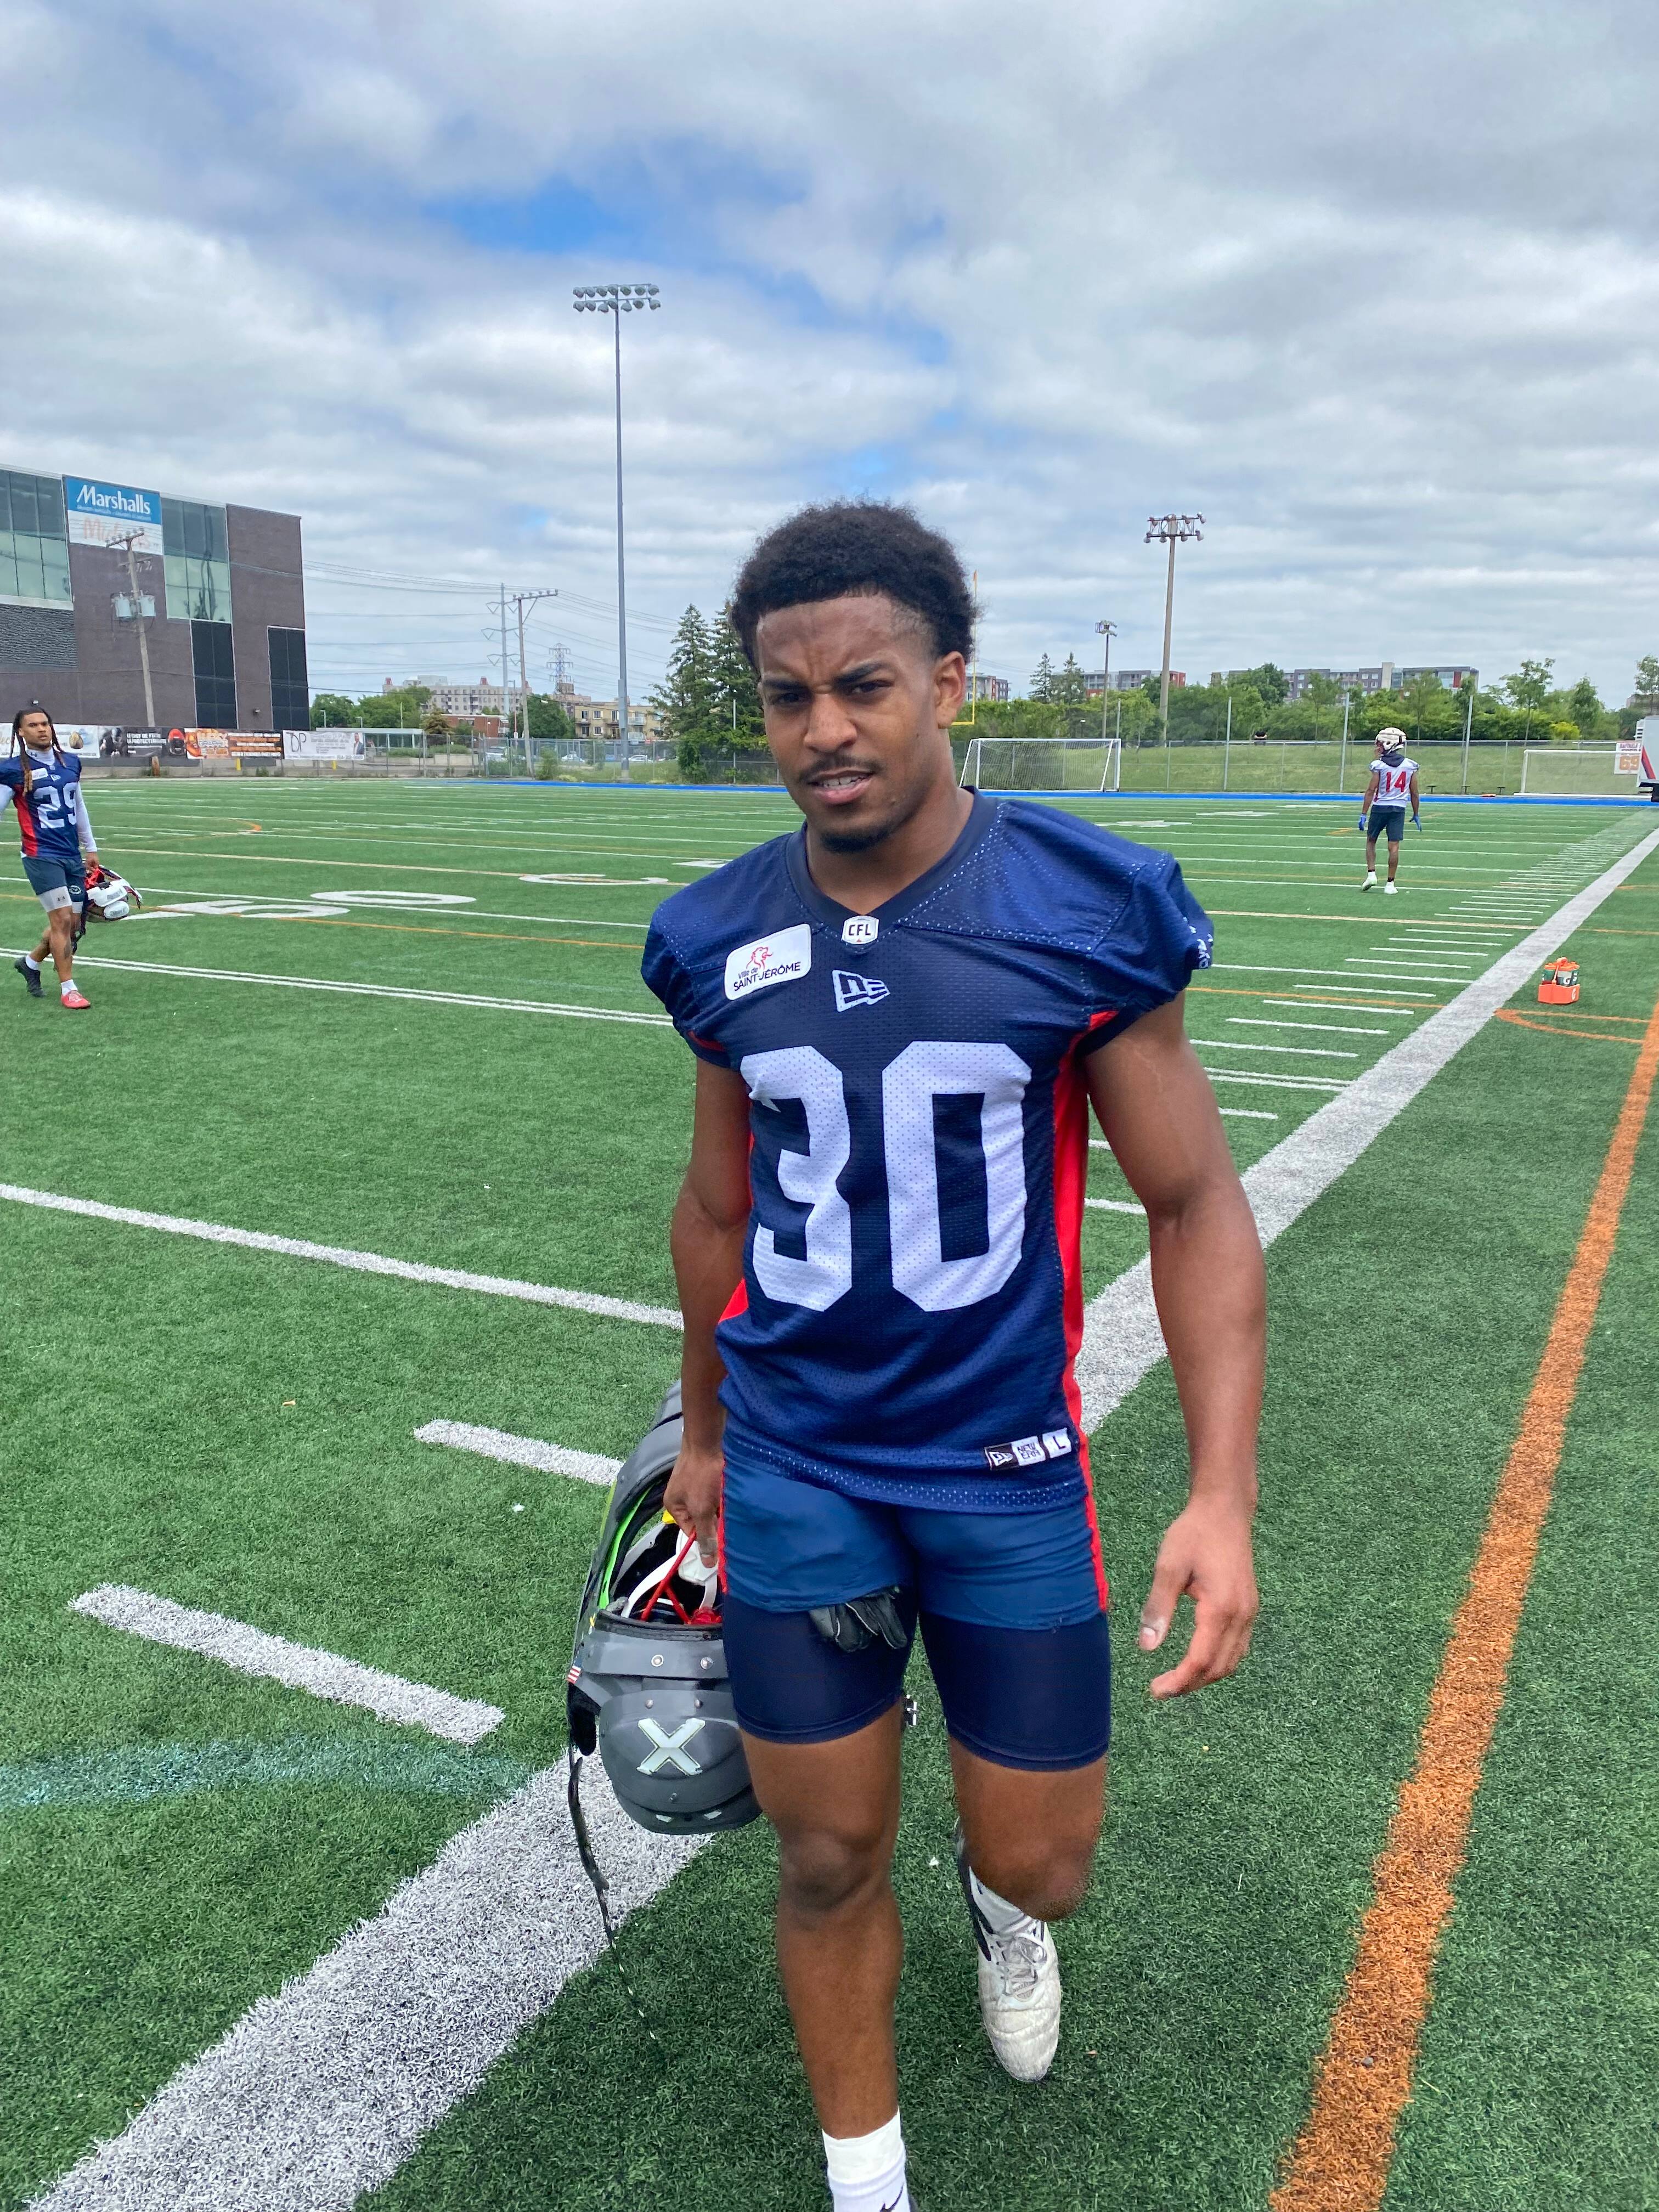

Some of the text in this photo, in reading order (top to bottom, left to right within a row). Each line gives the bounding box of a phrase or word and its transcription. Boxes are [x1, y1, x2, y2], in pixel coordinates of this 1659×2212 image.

[77, 484, 151, 515] Marshalls
[1386, 771, 1406, 793] 14
[33, 782, 77, 828] 29
[848, 923, 871, 936] CFL
[733, 961, 801, 991] SAINT-JÉRÔME
[738, 970, 750, 979] Ville
[740, 1041, 1031, 1312] 30
[1017, 1442, 1036, 1453] NEW
[1052, 1435, 1066, 1450] L
